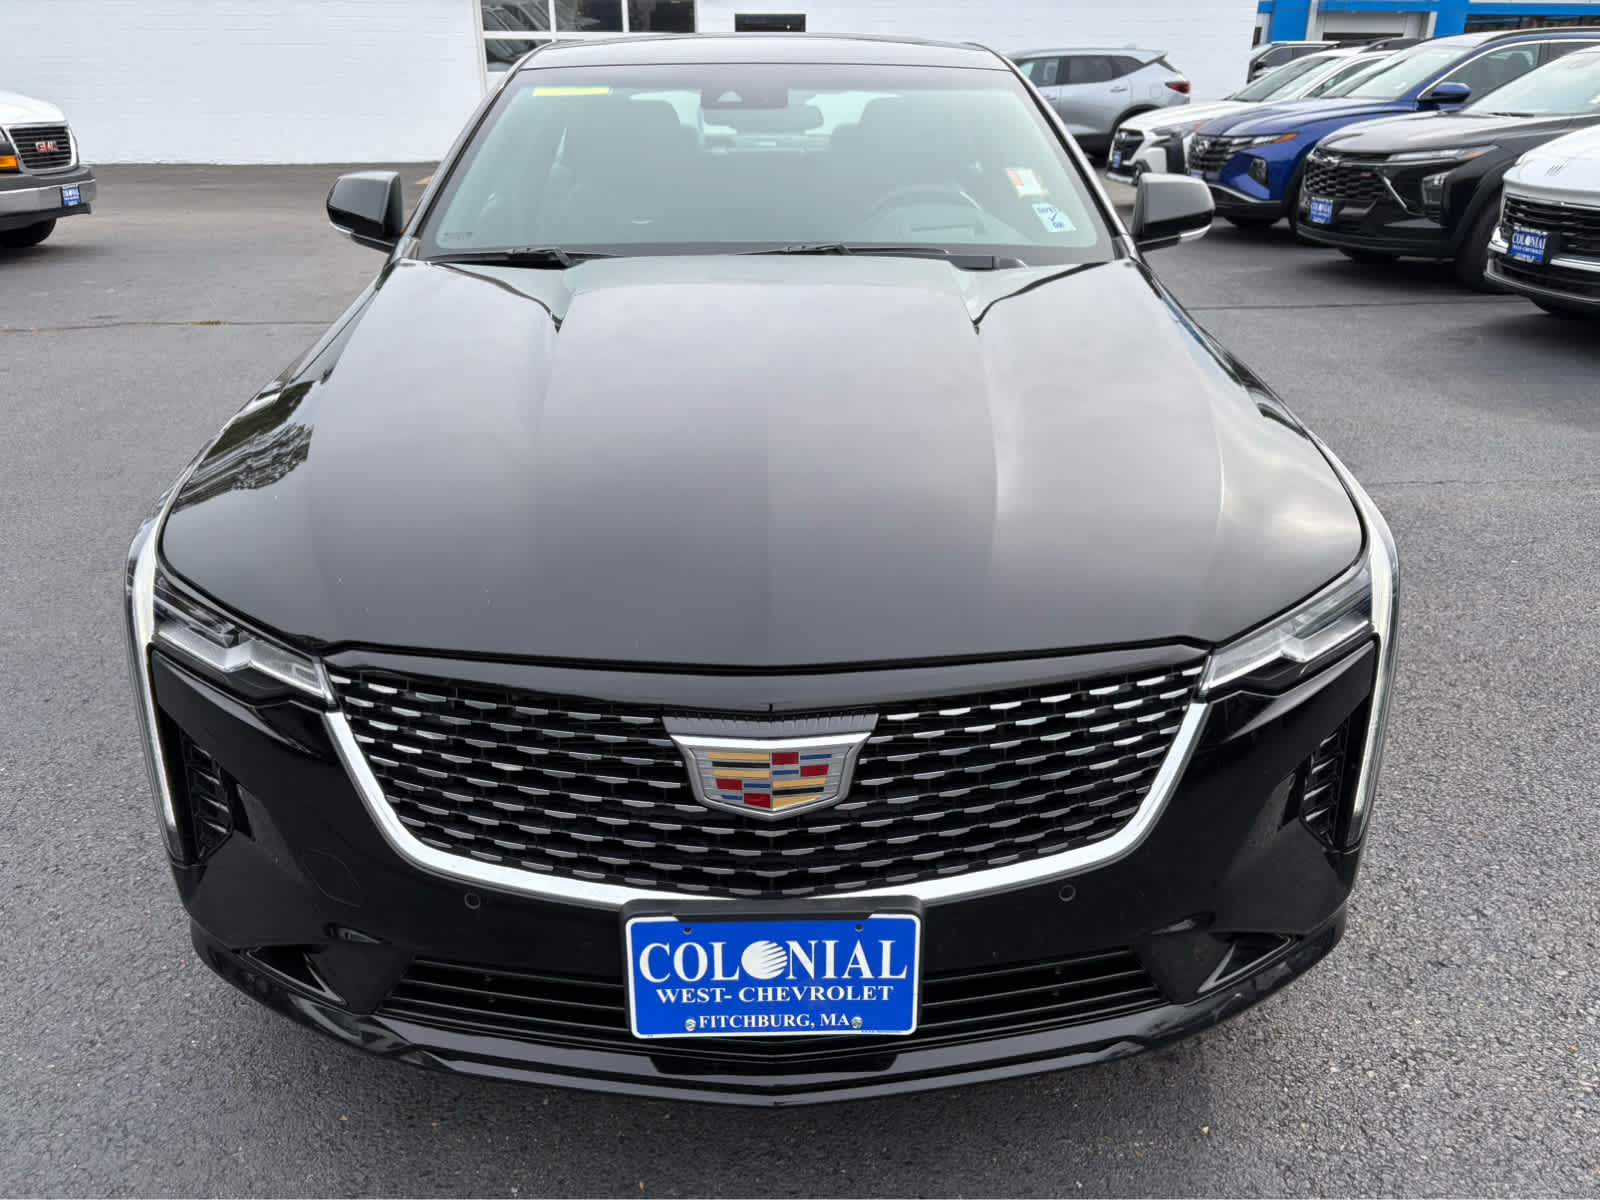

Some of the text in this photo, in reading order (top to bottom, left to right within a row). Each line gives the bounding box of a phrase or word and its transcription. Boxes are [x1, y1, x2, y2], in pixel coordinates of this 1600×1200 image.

[639, 939, 908, 983] COLONIAL
[656, 986, 894, 1004] WEST- CHEVROLET
[699, 1012, 850, 1029] FITCHBURG, MA
